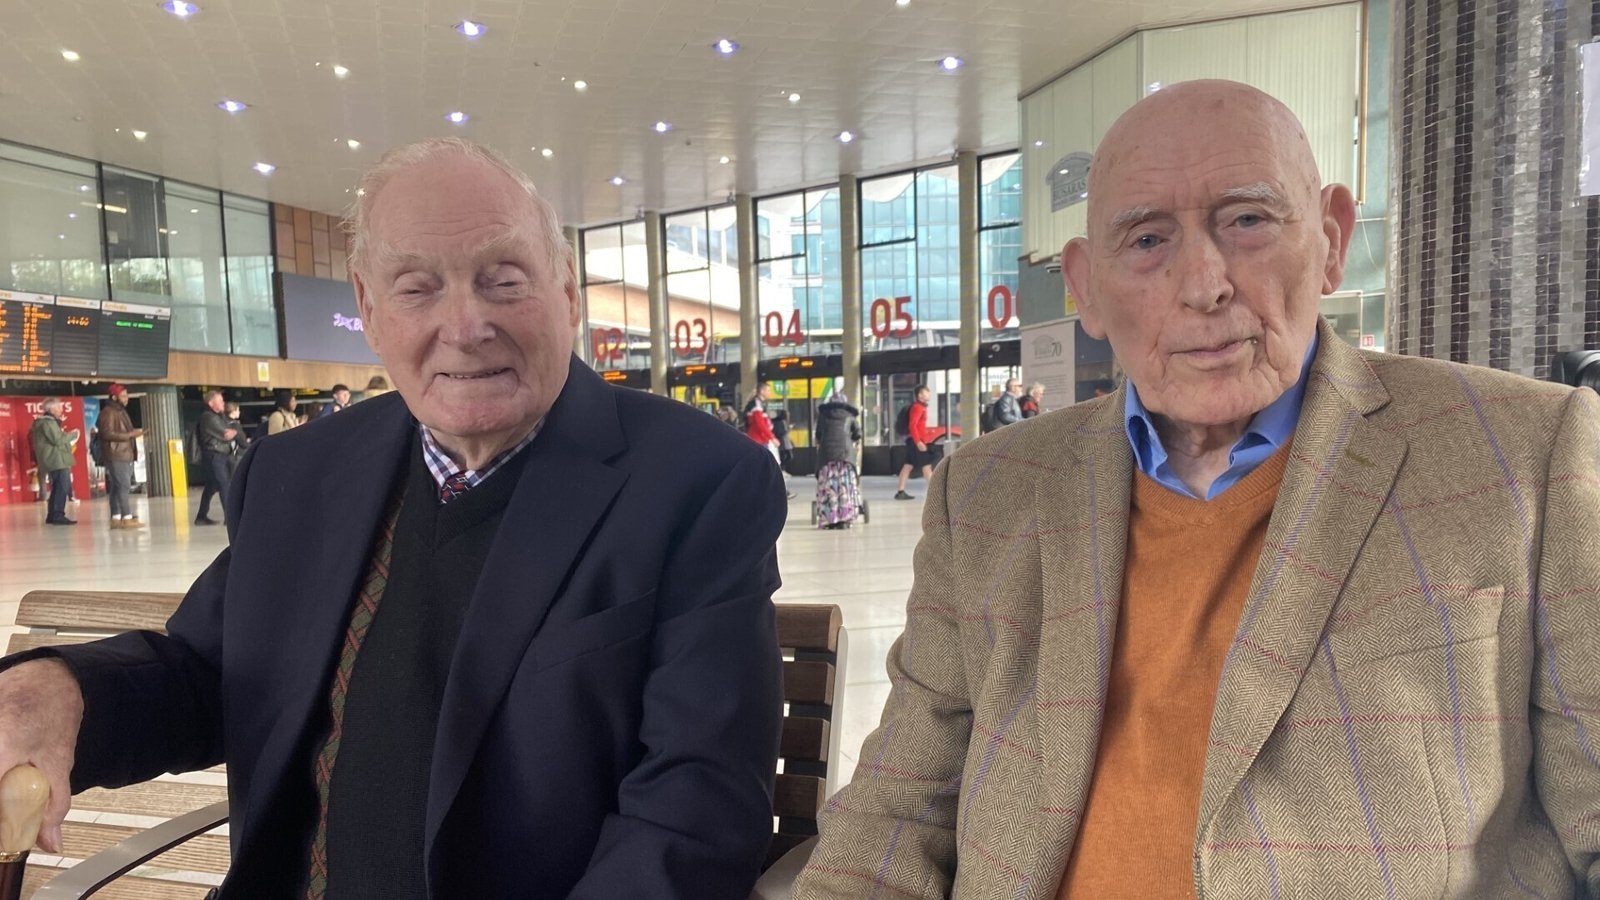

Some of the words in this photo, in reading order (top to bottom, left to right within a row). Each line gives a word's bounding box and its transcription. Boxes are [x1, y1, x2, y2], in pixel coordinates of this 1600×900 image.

[870, 296, 913, 339] 05
[987, 285, 1019, 331] 0
[592, 327, 622, 361] 02
[674, 318, 708, 356] 03
[764, 309, 805, 348] 04
[25, 402, 73, 414] TICTS
